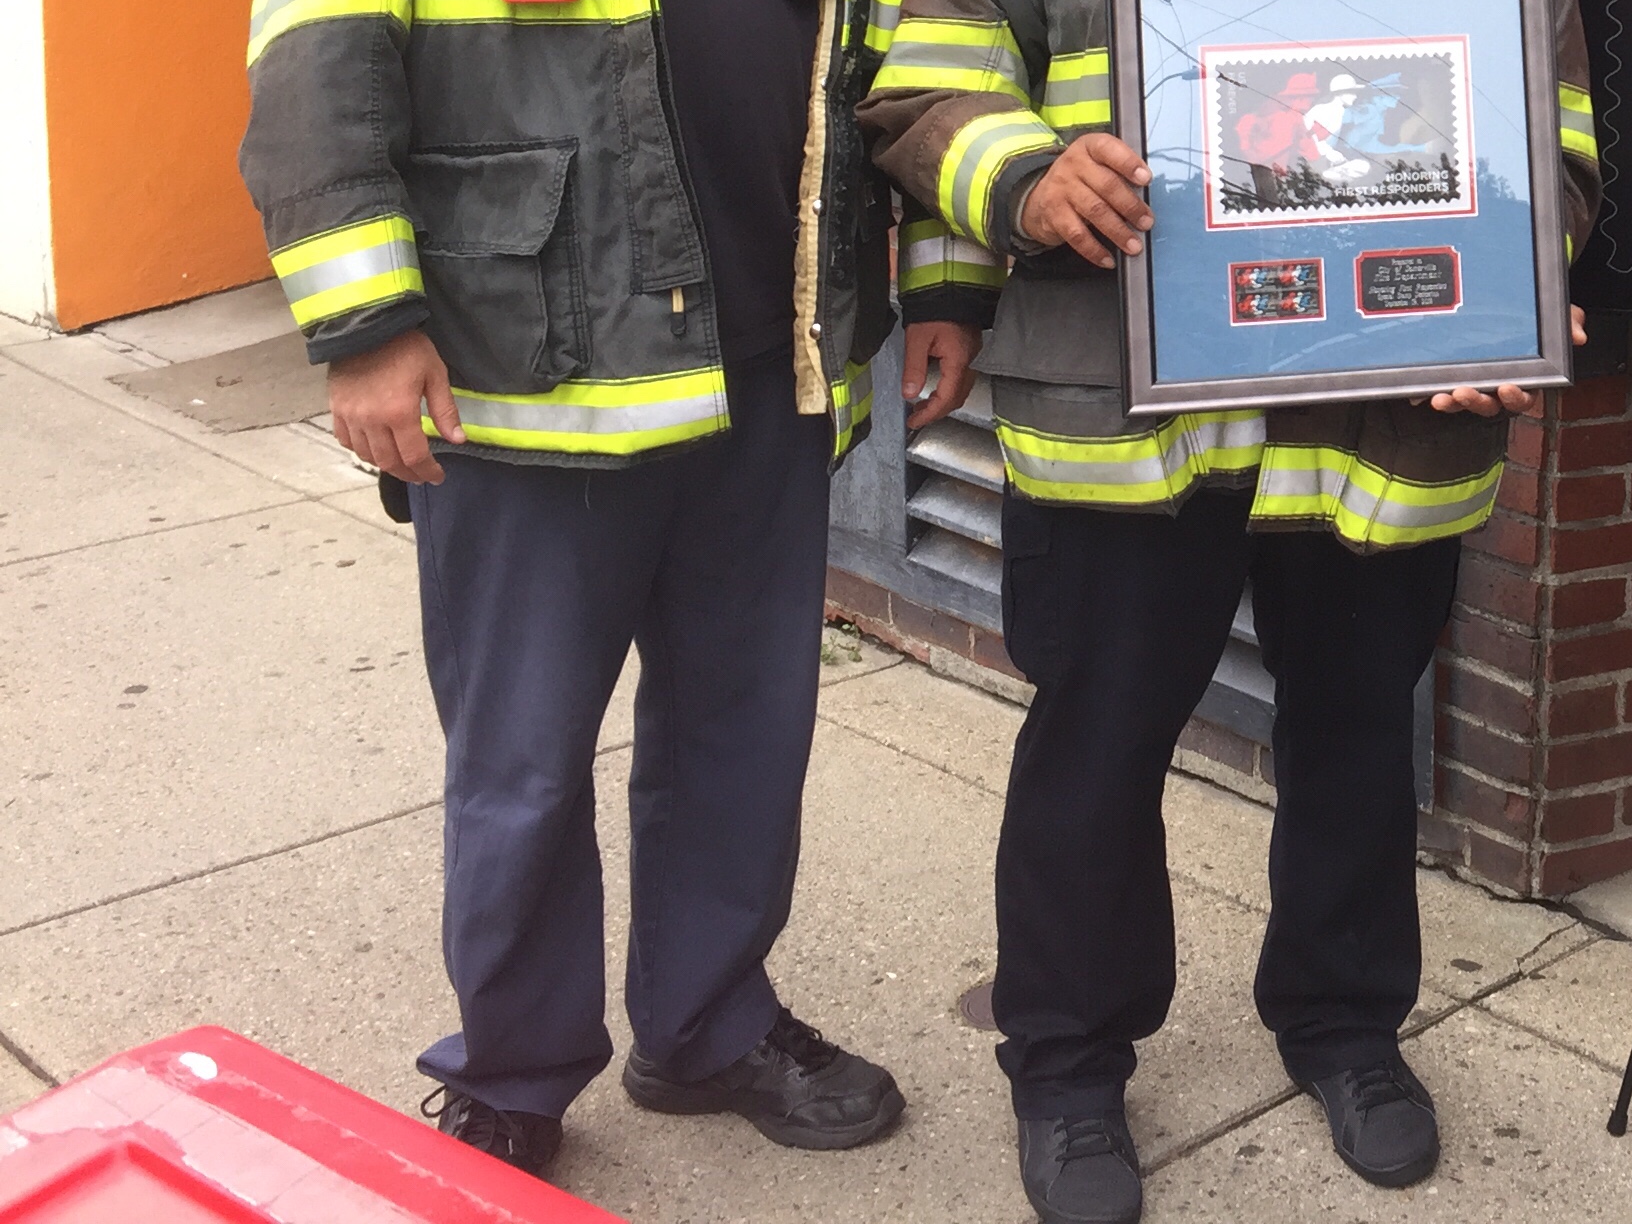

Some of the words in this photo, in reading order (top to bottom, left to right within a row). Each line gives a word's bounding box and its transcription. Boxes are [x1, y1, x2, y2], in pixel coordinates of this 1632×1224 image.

[1385, 170, 1449, 182] HONORING
[1335, 186, 1369, 197] FIRST
[1371, 182, 1449, 195] RESPONDERS
